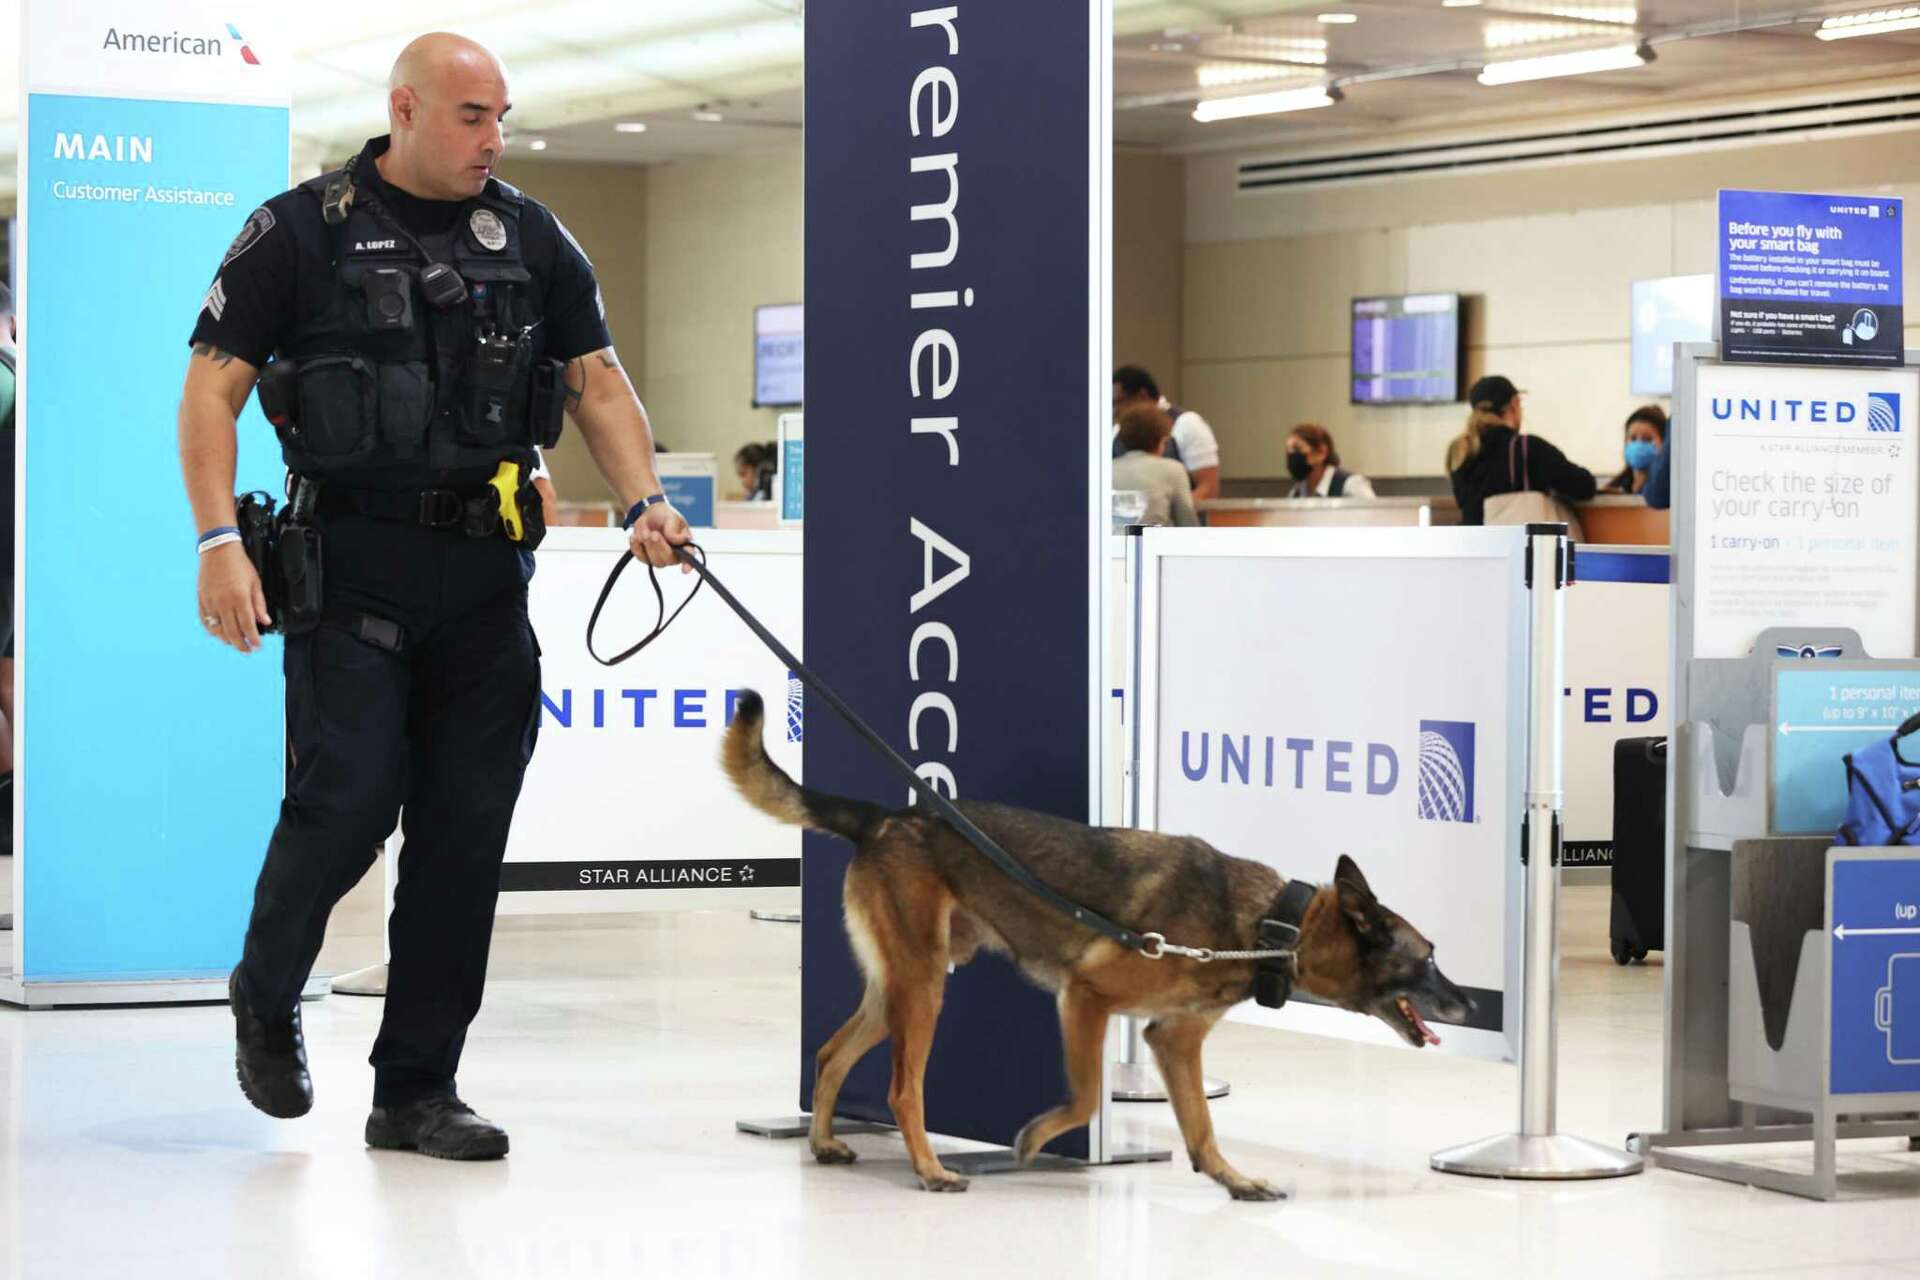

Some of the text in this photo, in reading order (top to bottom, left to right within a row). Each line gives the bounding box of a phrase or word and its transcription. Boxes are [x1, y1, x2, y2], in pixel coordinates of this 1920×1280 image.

[103, 28, 221, 56] American
[53, 132, 152, 163] MAIN
[53, 181, 235, 206] Customer Assistance
[1830, 206, 1867, 216] UNITED
[1729, 222, 1842, 240] Before you fly with
[355, 240, 395, 250] A. LOPEZ
[1729, 238, 1819, 254] your smart bag
[1743, 254, 1766, 263] battery
[1768, 255, 1795, 264] installed
[1798, 256, 1804, 264] in
[1806, 258, 1819, 266] your
[1841, 258, 1853, 267] bag
[1854, 259, 1870, 267] must
[1871, 260, 1880, 268] be
[1729, 264, 1759, 272] removed
[1760, 264, 1781, 272] before
[1782, 266, 1810, 274] checking
[1826, 268, 1853, 277] carrying
[1730, 286, 1742, 295] bag
[1773, 288, 1798, 296] allowed
[1814, 280, 1838, 288] remove
[1840, 280, 1850, 288] the
[1878, 282, 1888, 290] the
[1730, 310, 1742, 318] Not
[1778, 312, 1794, 320] have
[1820, 314, 1835, 323] bag?
[1712, 398, 1856, 423] UNITED
[1795, 444, 1840, 454] ALLIANCE
[1712, 470, 1893, 494] Check the size of
[1712, 498, 1859, 521] your carry-on
[1712, 536, 1716, 549] 1
[1722, 536, 1780, 551] carry-on
[1830, 686, 1836, 700] 1
[1841, 685, 1896, 701] personal
[539, 689, 740, 728] NITE
[1564, 688, 1658, 723] ED
[1843, 707, 1854, 719] to
[1182, 731, 1399, 795] UNITED
[1557, 848, 1613, 862] LLIAN
[579, 867, 732, 884] STAR ALLIANCE
[1895, 902, 1918, 920] (up
